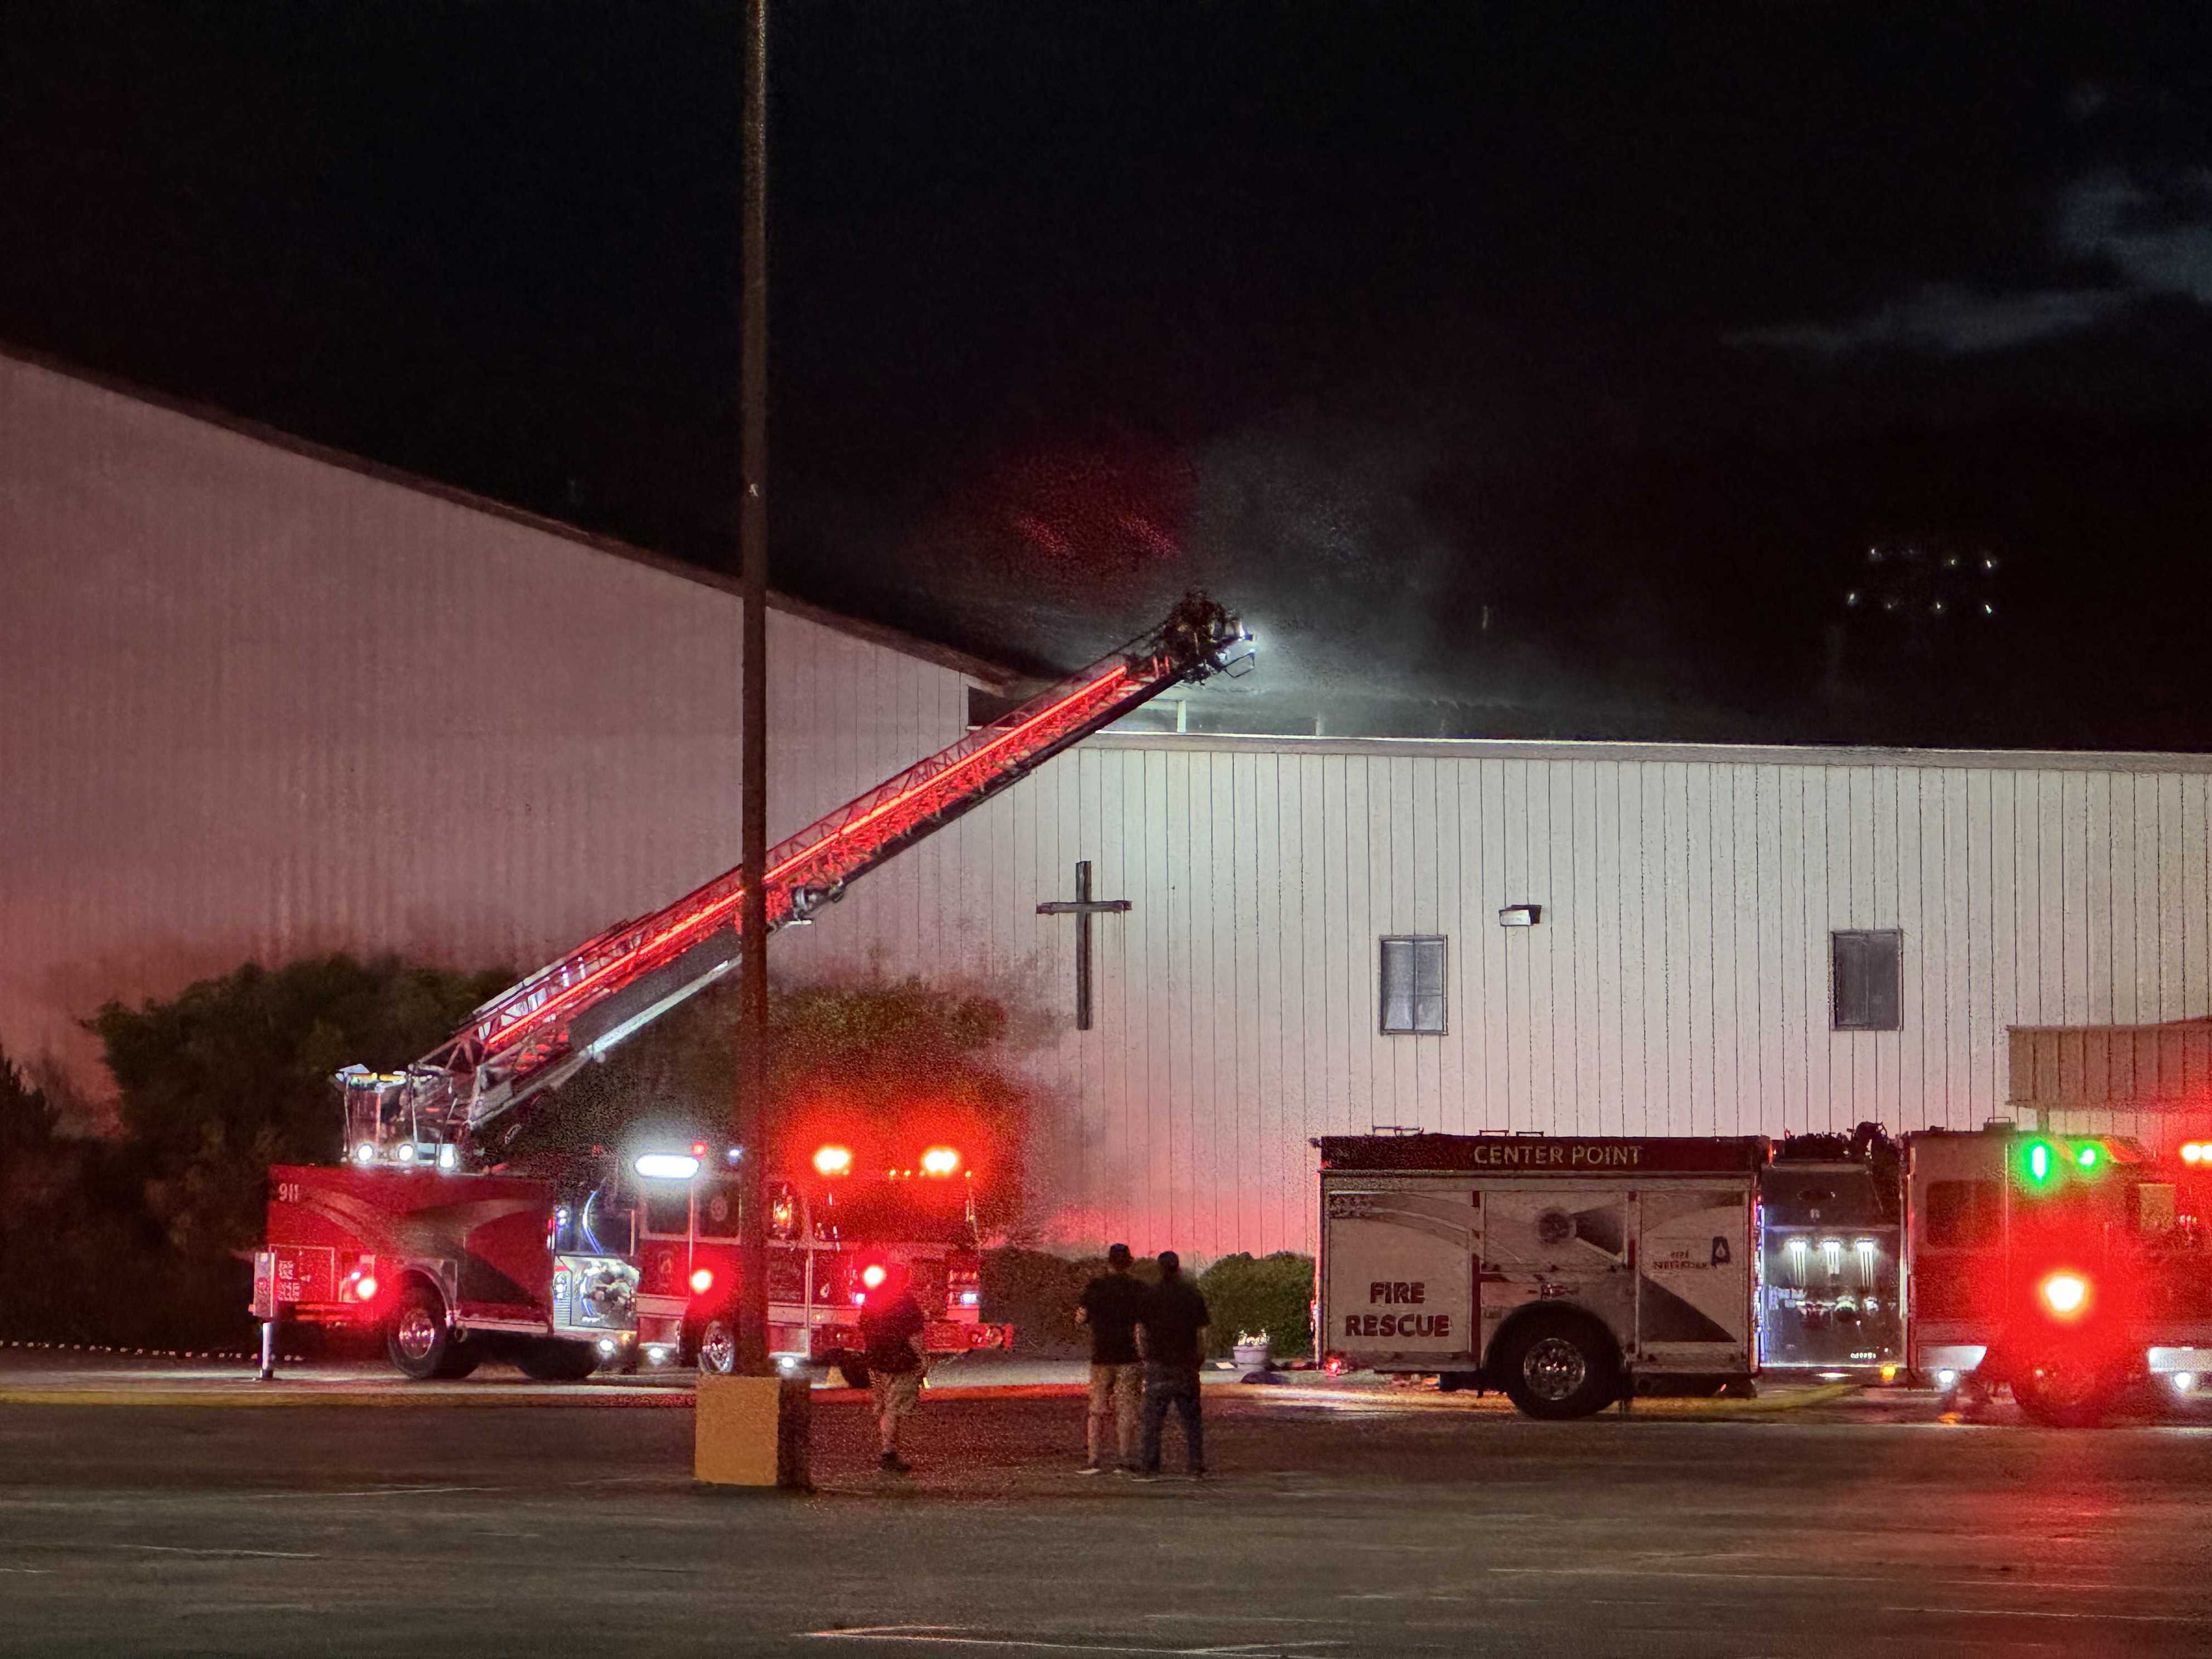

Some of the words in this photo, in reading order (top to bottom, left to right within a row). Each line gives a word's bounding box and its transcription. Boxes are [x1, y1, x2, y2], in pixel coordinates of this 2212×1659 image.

[1474, 1145, 1563, 1164] CENTER
[1572, 1145, 1643, 1165] POINT
[279, 1183, 299, 1202] 911
[1370, 1282, 1425, 1304] FIRE
[1345, 1314, 1450, 1337] RESCUE
